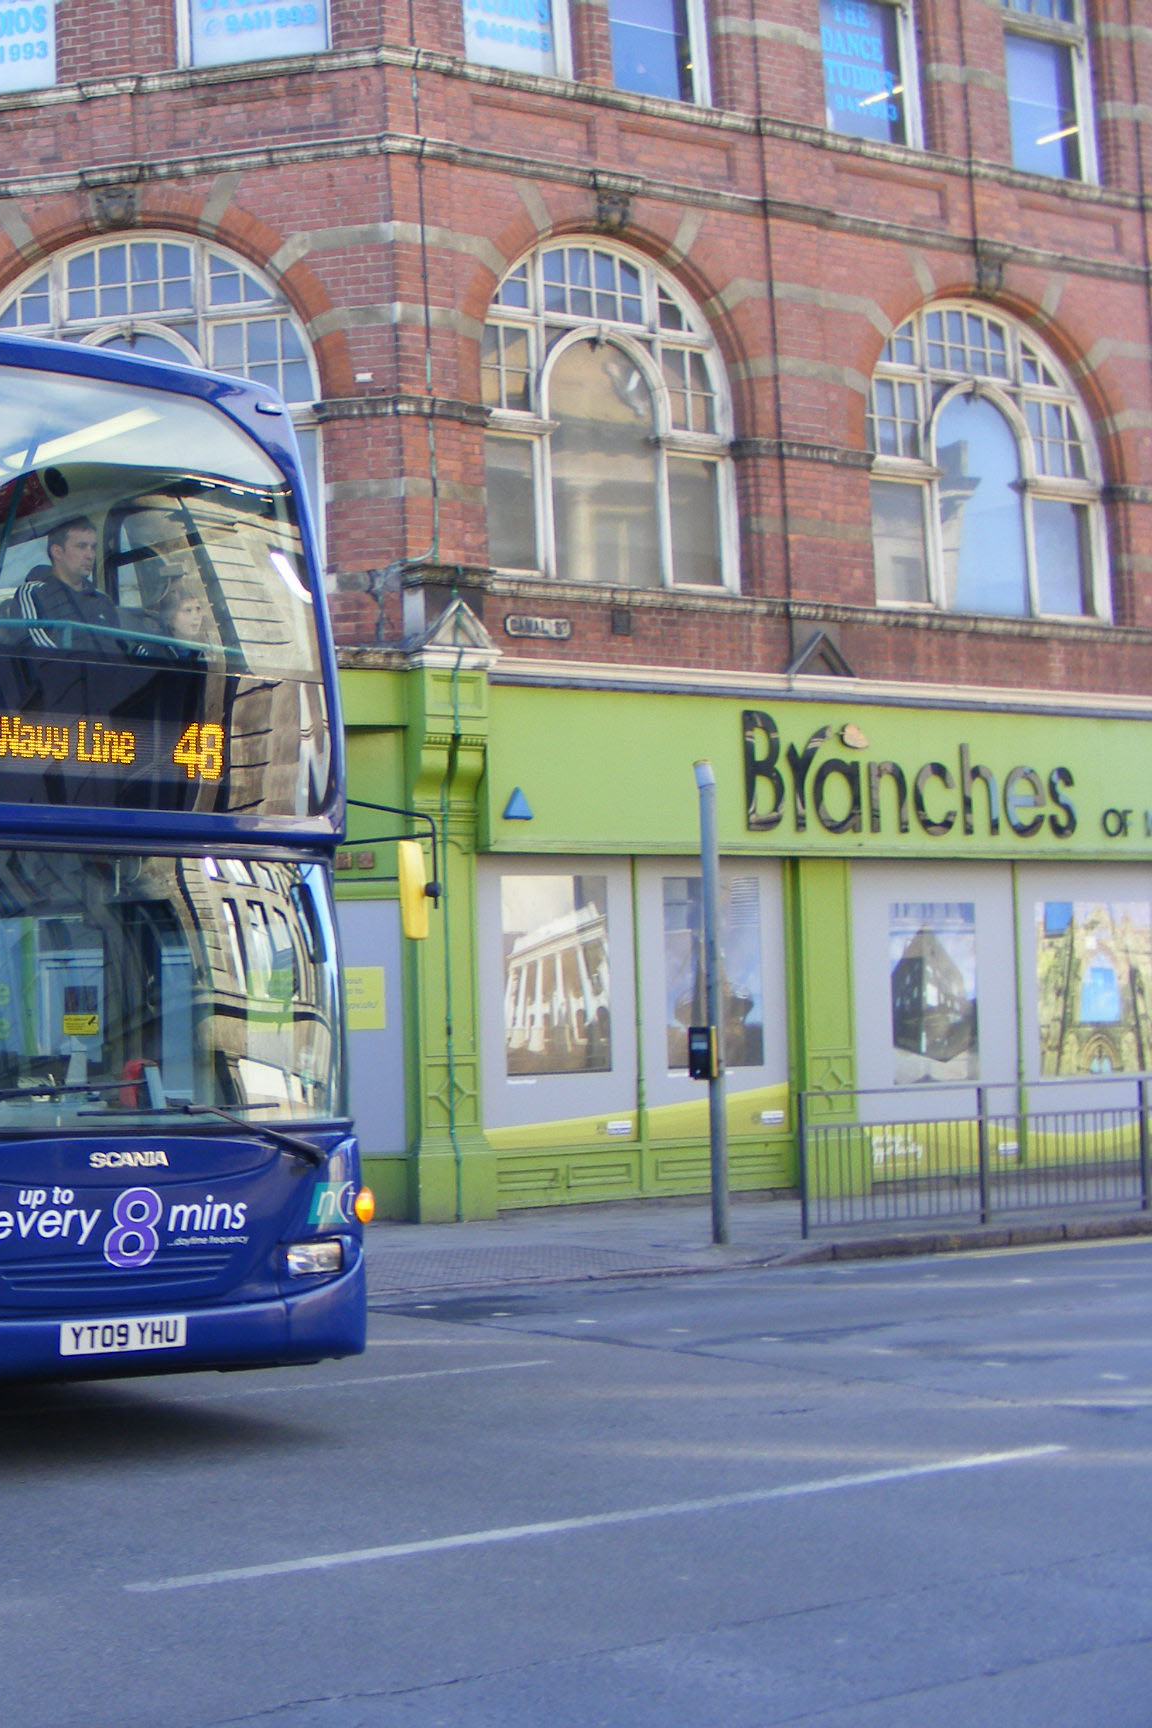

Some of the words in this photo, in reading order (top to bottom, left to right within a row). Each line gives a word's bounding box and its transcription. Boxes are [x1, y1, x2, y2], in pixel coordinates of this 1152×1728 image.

[820, 25, 883, 63] DANCE
[823, 58, 894, 94] TUDIOS
[0, 715, 69, 760] Navy
[76, 720, 136, 764] Line
[172, 722, 224, 780] 48
[741, 710, 1078, 838] Branches
[89, 1150, 170, 1169] SCANIA
[17, 1188, 47, 1209] up
[51, 1186, 75, 1205] to
[103, 1186, 164, 1268] 8
[167, 1194, 248, 1232] mins
[70, 1323, 130, 1350] YT09
[136, 1319, 178, 1345] YHU
